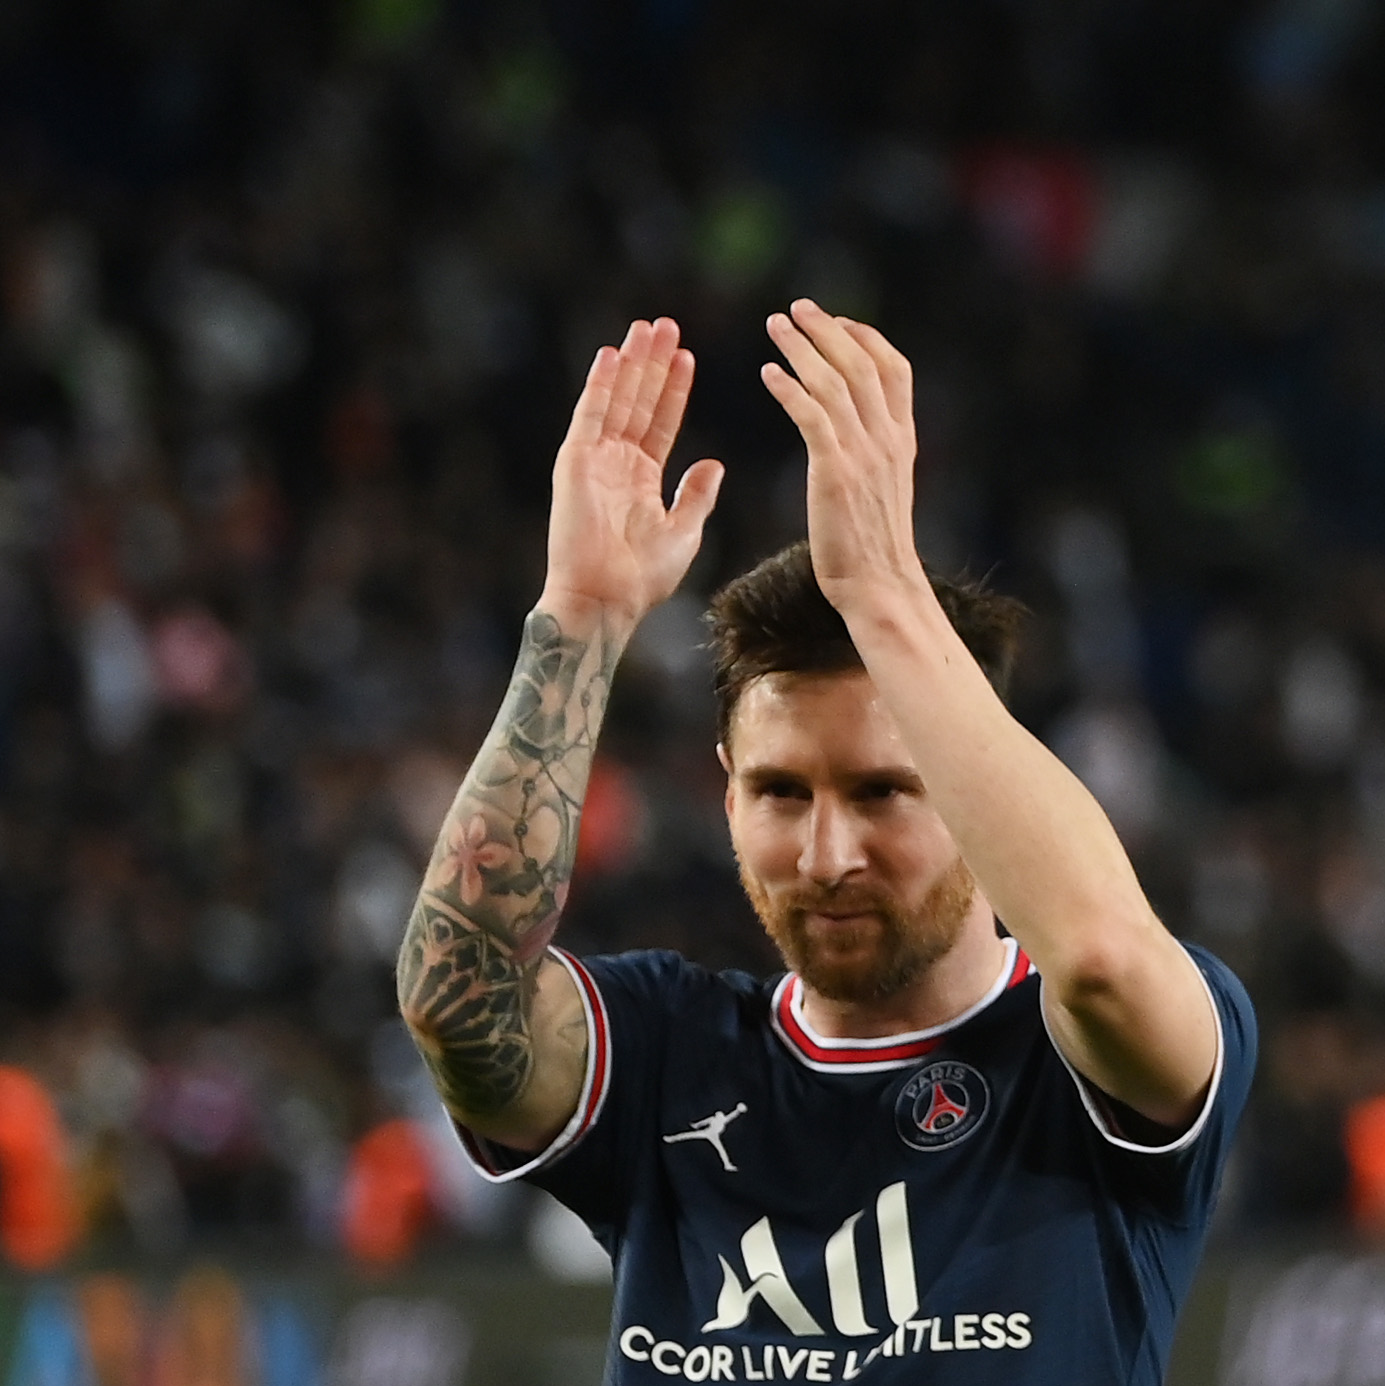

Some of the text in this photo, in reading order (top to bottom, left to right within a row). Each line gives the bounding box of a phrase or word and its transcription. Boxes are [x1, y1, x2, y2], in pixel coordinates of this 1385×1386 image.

[904, 1065, 965, 1099] PARIS
[619, 1311, 1033, 1383] CCOR LIVE LITLESS
